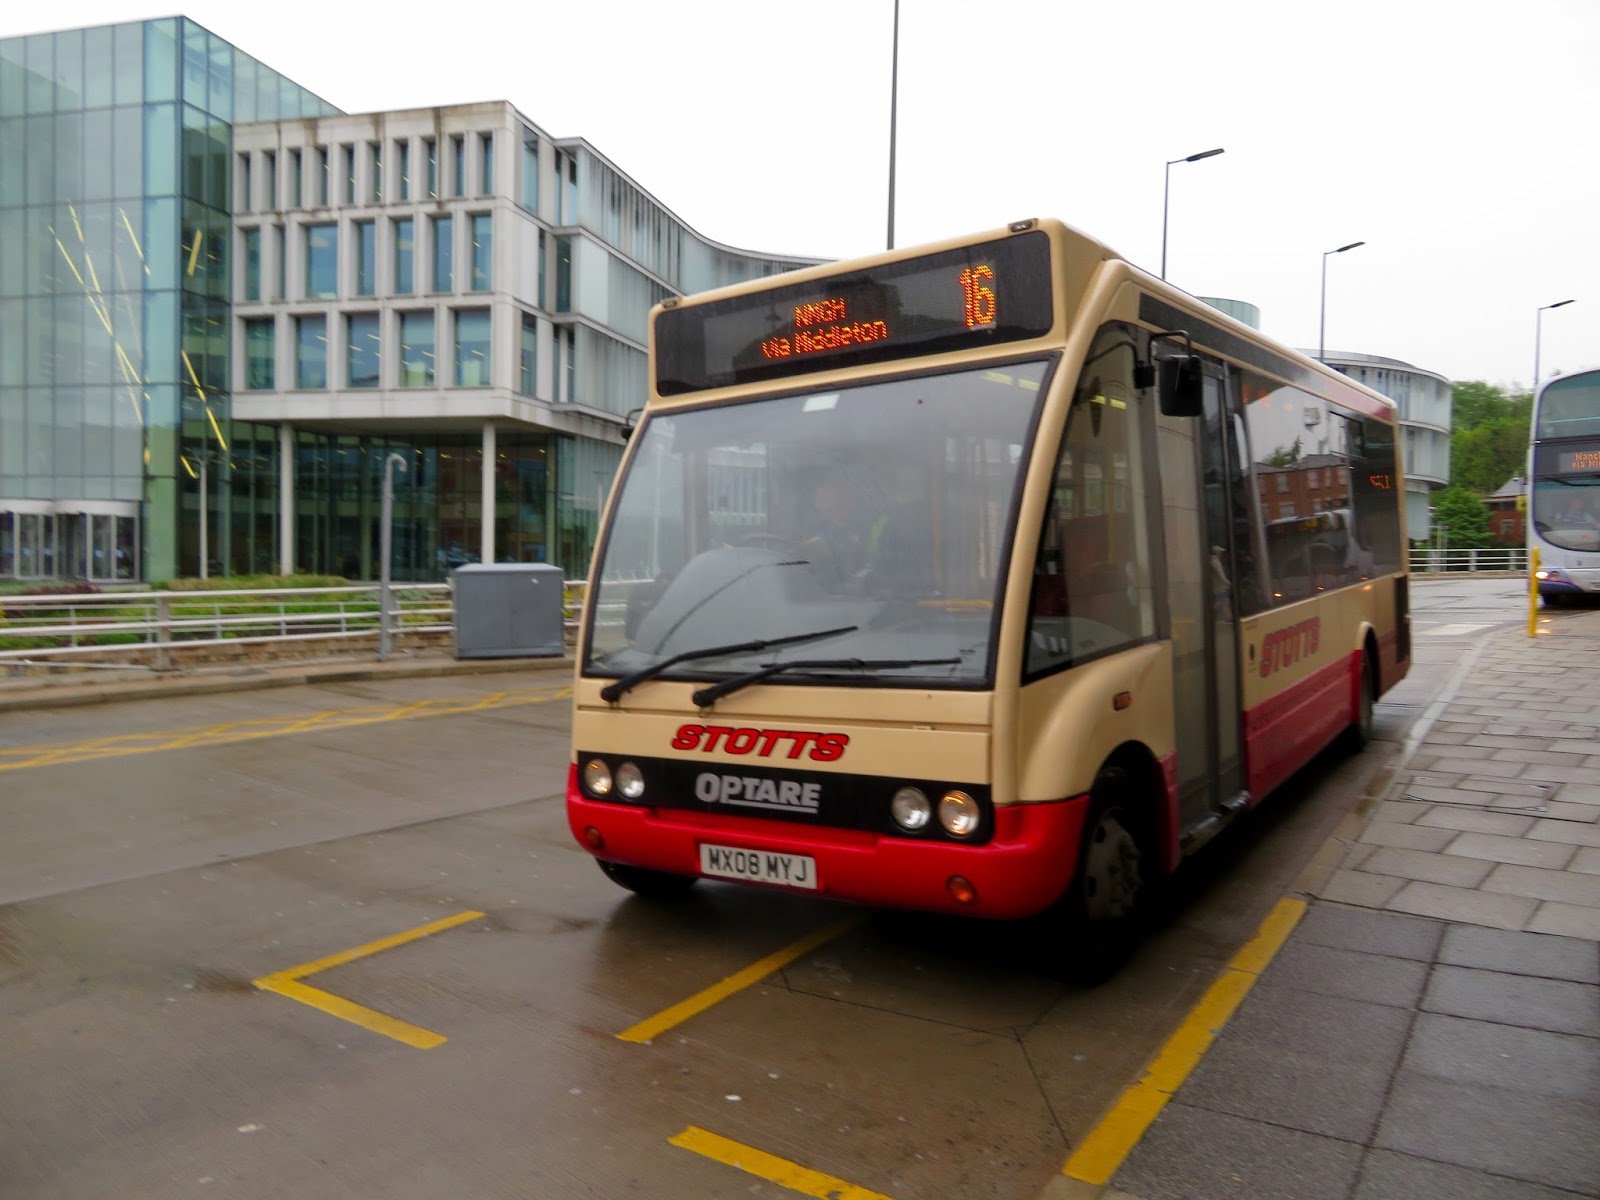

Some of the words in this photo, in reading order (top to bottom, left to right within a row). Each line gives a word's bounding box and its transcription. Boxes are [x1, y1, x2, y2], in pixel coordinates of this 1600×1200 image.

[959, 264, 996, 327] 16
[671, 724, 849, 762] STOTTS
[695, 772, 822, 810] OPTARE
[708, 847, 759, 876] MX08
[766, 857, 806, 883] MYJ
